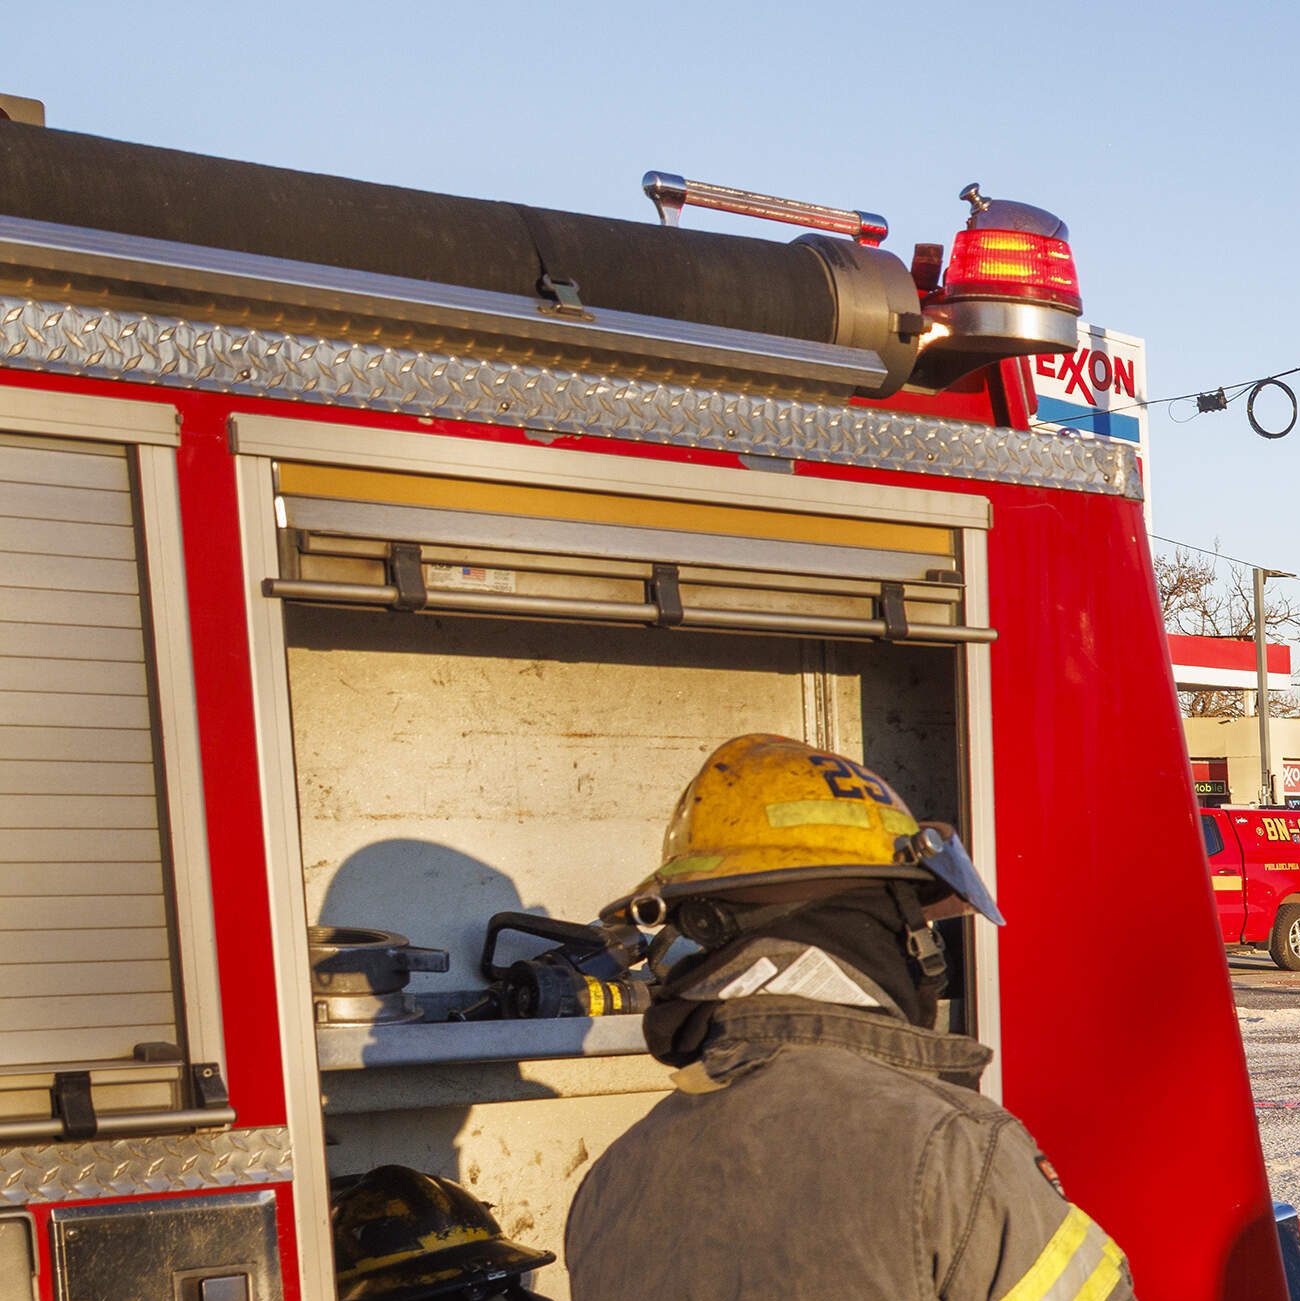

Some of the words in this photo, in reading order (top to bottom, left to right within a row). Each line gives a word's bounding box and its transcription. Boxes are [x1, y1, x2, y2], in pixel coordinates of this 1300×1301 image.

[1036, 347, 1135, 407] EXXON
[808, 755, 893, 805] 25
[1264, 863, 1300, 871] PHILADELPHIA
